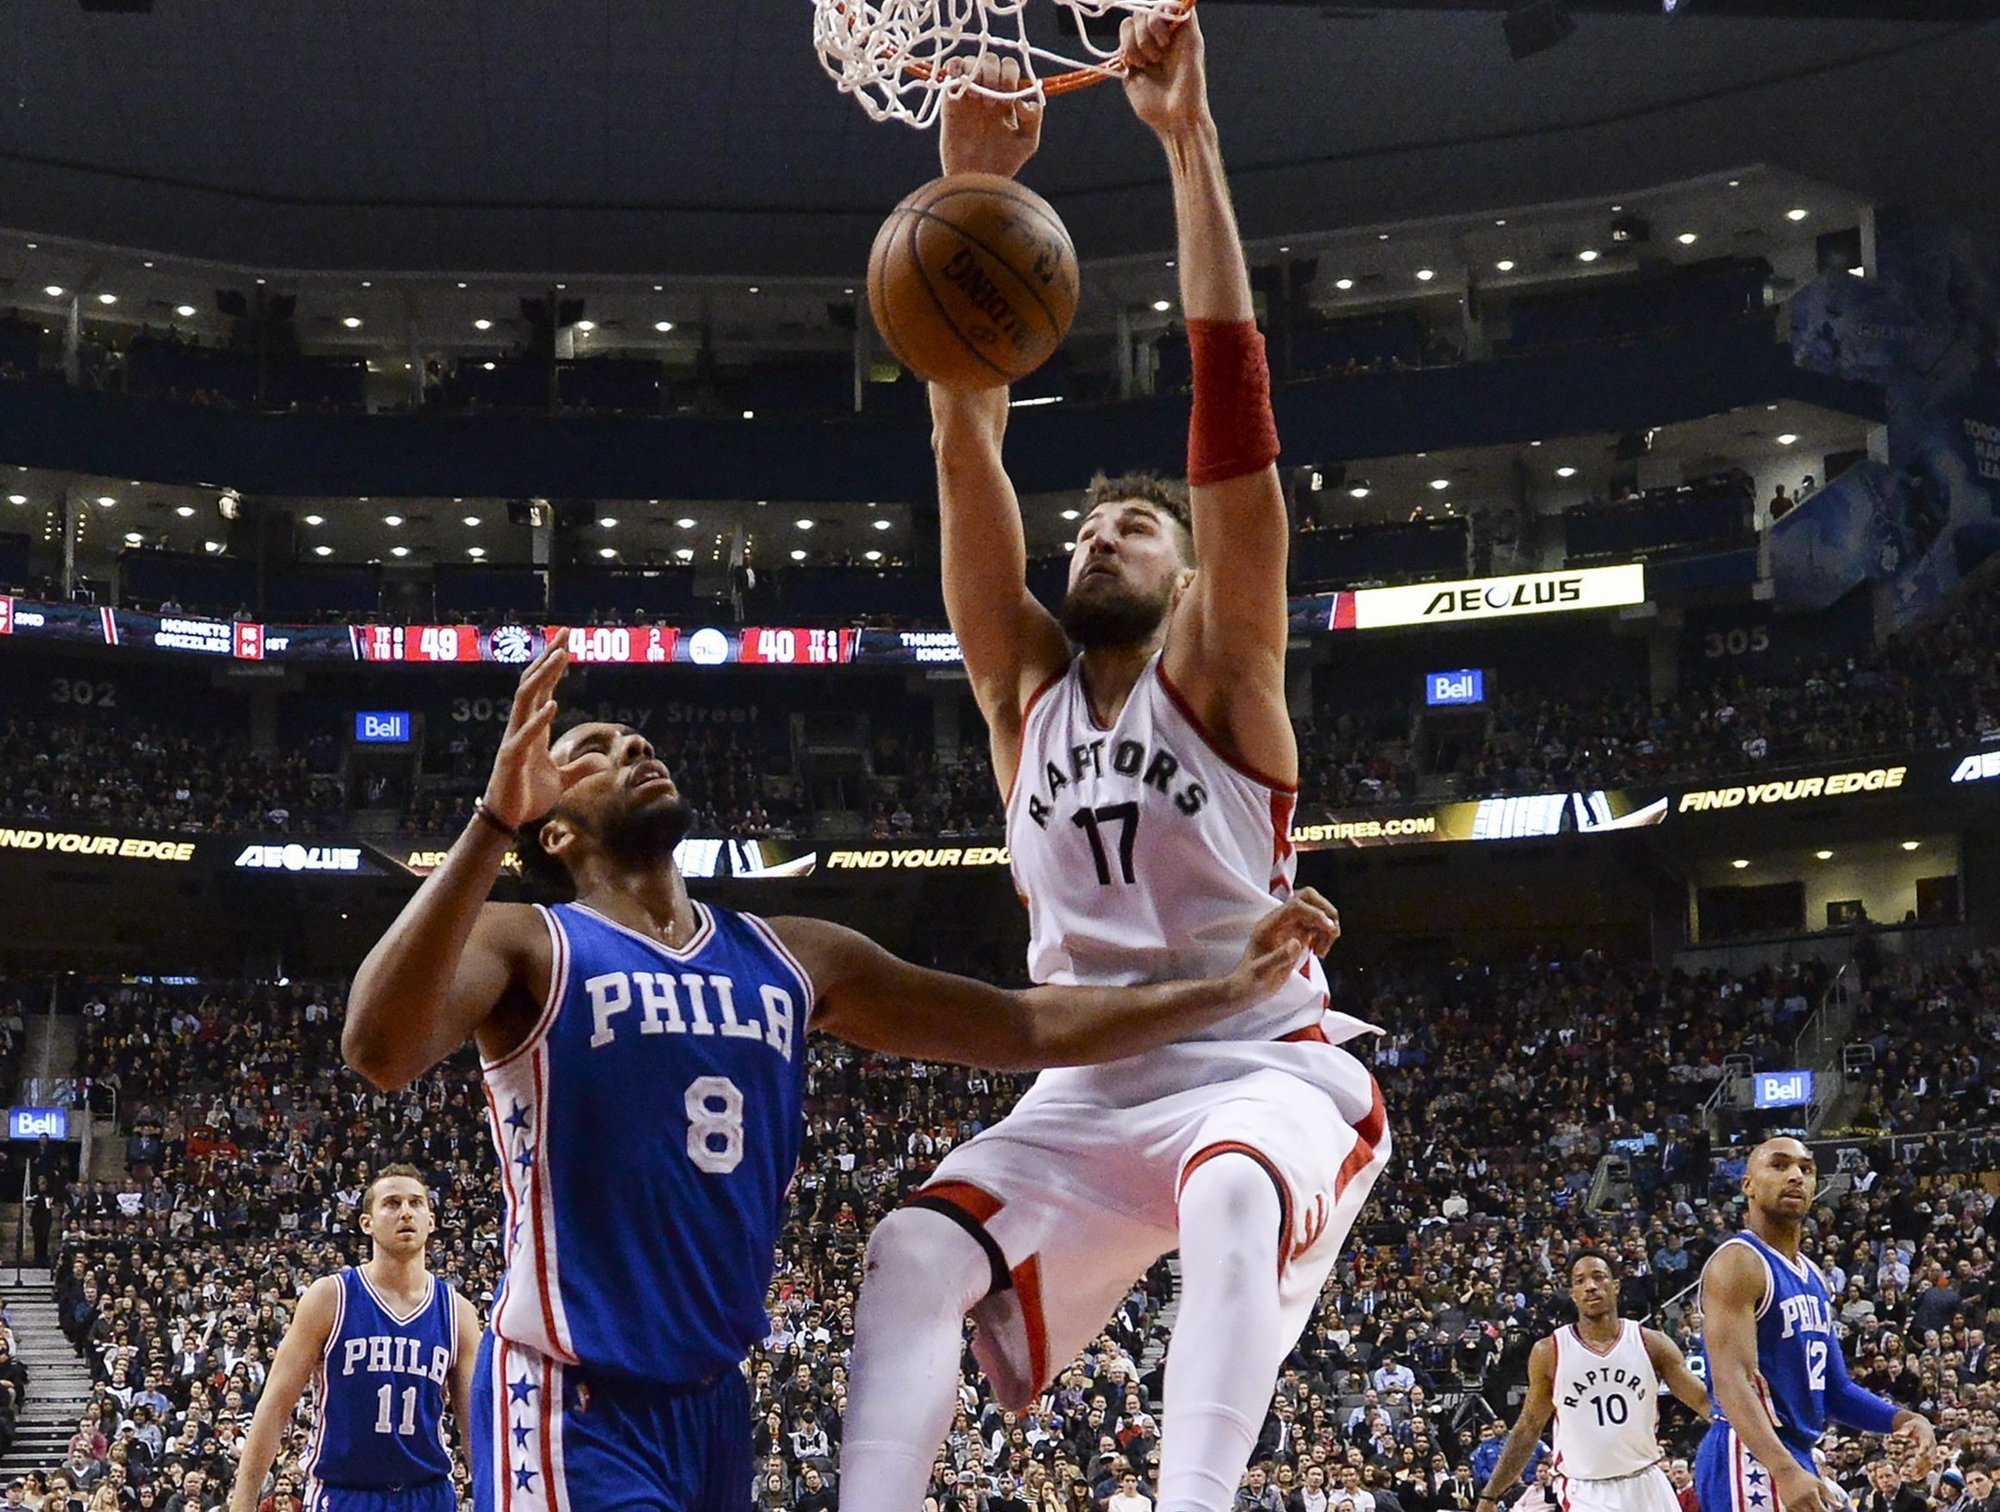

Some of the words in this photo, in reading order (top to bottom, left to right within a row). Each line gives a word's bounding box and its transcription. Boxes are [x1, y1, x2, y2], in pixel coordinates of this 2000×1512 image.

[1423, 578, 1583, 615] AEOLUS
[154, 632, 231, 653] GRIZZLIES
[160, 618, 231, 638] HORNETS
[420, 627, 459, 661] 49
[568, 627, 630, 662] 4:00
[900, 632, 959, 647] THUNDE
[1704, 625, 1769, 659] 305
[757, 629, 795, 663] 40
[916, 647, 964, 661] KNICK
[50, 677, 117, 707] 302
[1435, 676, 1473, 700] Bell
[365, 716, 401, 737] Bell
[666, 701, 760, 723] Street
[1028, 738, 1209, 831] RAPTORS
[1679, 786, 1748, 813] FIND
[1746, 777, 1826, 804] YOUR
[1823, 767, 1907, 795] EDGE
[45, 832, 120, 856] YOUR
[118, 839, 196, 861] EDGE
[1071, 800, 1140, 885] 17
[1288, 817, 1436, 842] USTIRES.COM
[234, 844, 362, 872] AEOLUS
[827, 850, 892, 869] FIND
[890, 848, 963, 868] YOUR
[961, 847, 1012, 866] EDG
[584, 971, 795, 1063] PHILA
[1764, 1077, 1802, 1101] Bell
[18, 1112, 57, 1135] Bell
[683, 1075, 745, 1175] 8
[1779, 1293, 1831, 1338] PHIL
[342, 1335, 450, 1386] PHILA
[1563, 1367, 1646, 1409] RAPTORS
[374, 1383, 417, 1436] 11
[1589, 1393, 1629, 1427] 10
